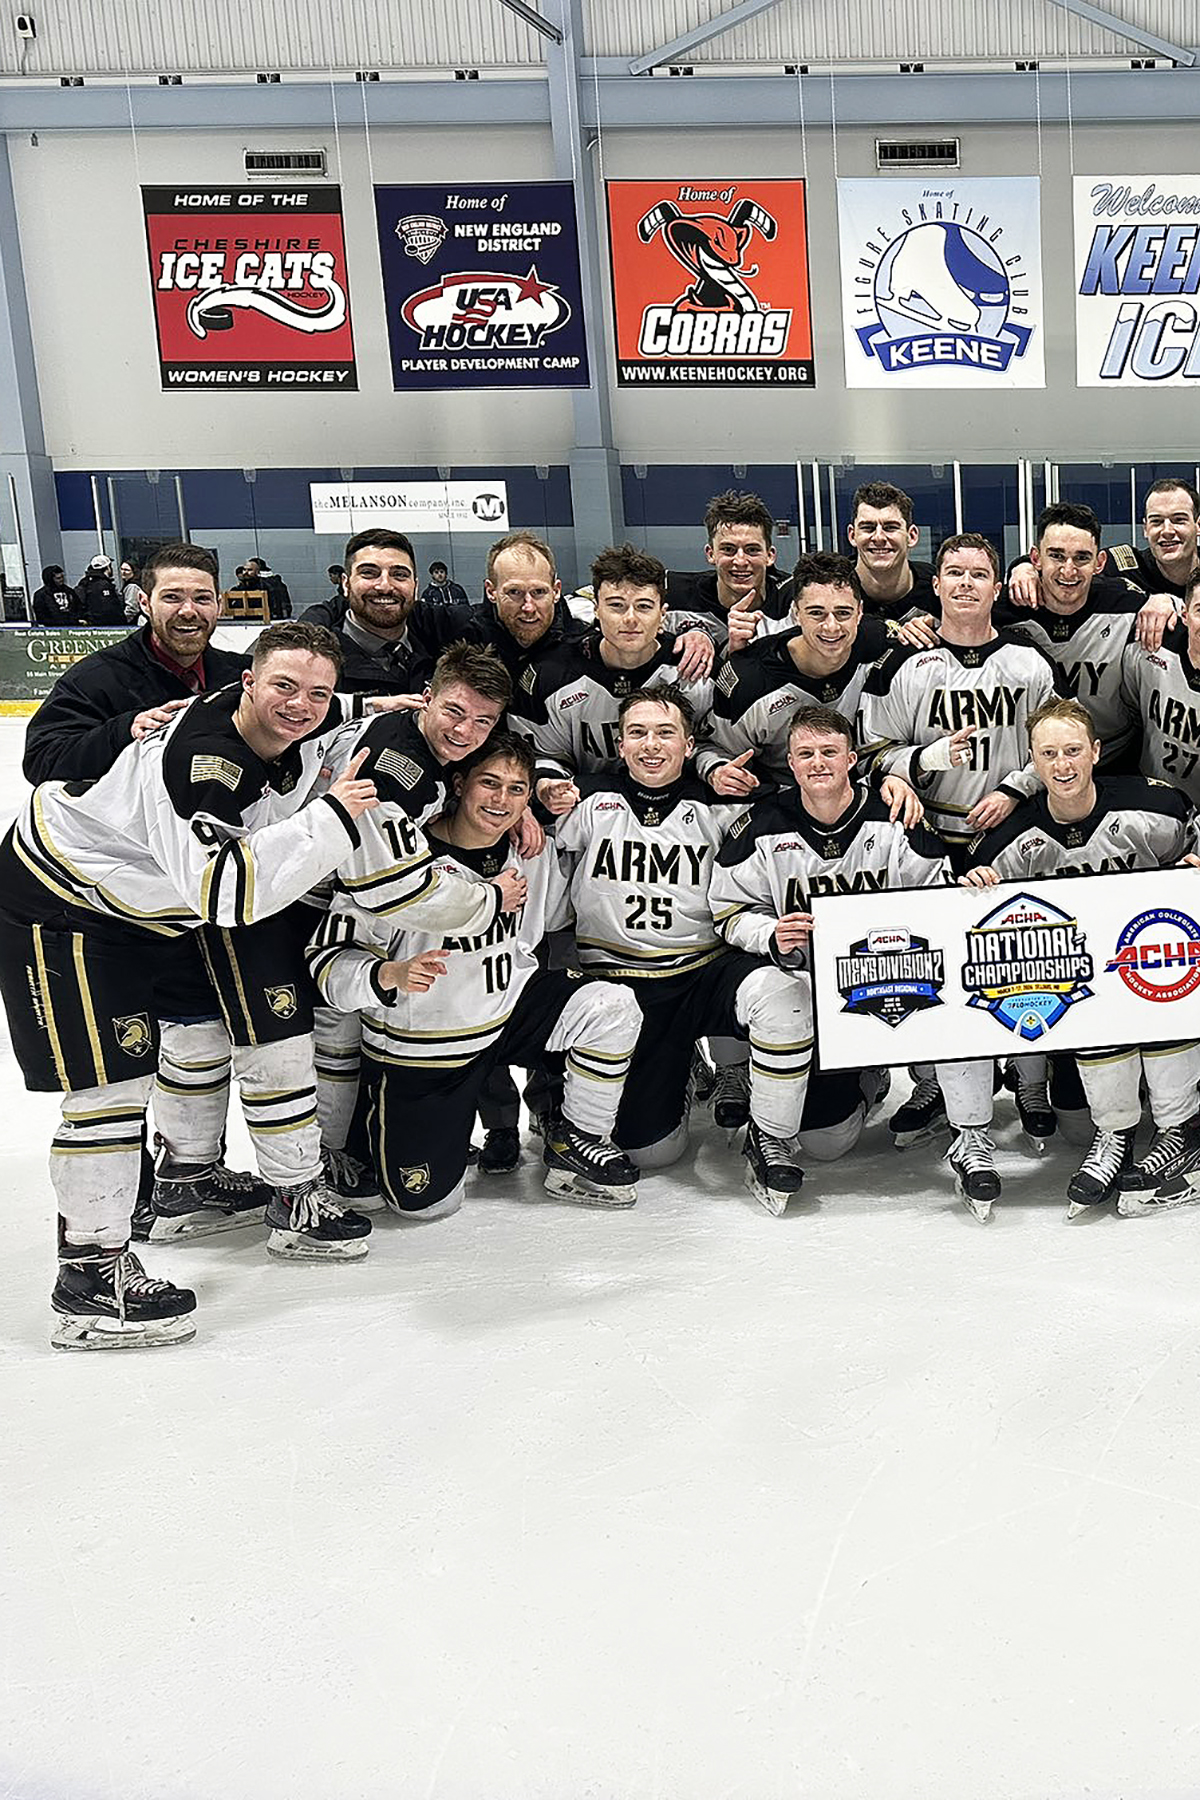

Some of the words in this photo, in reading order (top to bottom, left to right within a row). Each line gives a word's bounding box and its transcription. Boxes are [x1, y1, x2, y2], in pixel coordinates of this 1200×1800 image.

[174, 194, 231, 207] HOME
[238, 194, 264, 206] OF
[271, 193, 308, 206] THE
[445, 195, 488, 210] Home
[491, 194, 508, 211] of
[678, 187, 717, 201] Home
[719, 186, 736, 204] of
[922, 189, 943, 198] Home
[945, 189, 955, 200] of
[454, 223, 489, 237] NEW
[493, 222, 562, 236] ENGLAND
[174, 239, 321, 250] CHESHIRE
[477, 238, 542, 252] DISTRICT
[157, 252, 226, 290] ICE
[235, 252, 335, 290] CATS
[855, 227, 891, 315] FIGURE
[902, 201, 1003, 243] SKATING
[1005, 254, 1029, 315] CLUB
[287, 291, 325, 299] HOCKEY
[456, 288, 512, 317] USA
[420, 323, 547, 349] HOCKEY
[640, 306, 792, 357] COBRAS
[401, 358, 448, 371] PLAYER
[451, 358, 540, 370] DEVELOPMENT
[543, 357, 580, 369] CAMP
[889, 337, 1003, 368] KEENE
[168, 370, 260, 383] WOMEN'S
[267, 370, 349, 383] HOCKEY
[621, 366, 808, 381] WWW.KEENEHOCKEY.ORG
[329, 495, 407, 508] MELANSON
[928, 686, 1025, 731] ARMY
[967, 736, 990, 771] 11
[1163, 741, 1199, 779] 27
[591, 838, 710, 885] ARMY
[625, 895, 673, 930] 25
[1000, 912, 1048, 925] ACHA
[872, 936, 906, 945] ACHA
[1124, 912, 1155, 943] AMERICAN
[1158, 912, 1199, 938] COLLEGIATE
[970, 927, 1083, 963] NATIONAL
[482, 953, 512, 994] 10
[838, 956, 878, 990] MEN'S
[878, 952, 933, 981] DIVISION
[933, 951, 943, 982] 2
[964, 956, 1091, 986] CHAMPIONSHIPS
[1126, 972, 1153, 997] HOCKEY
